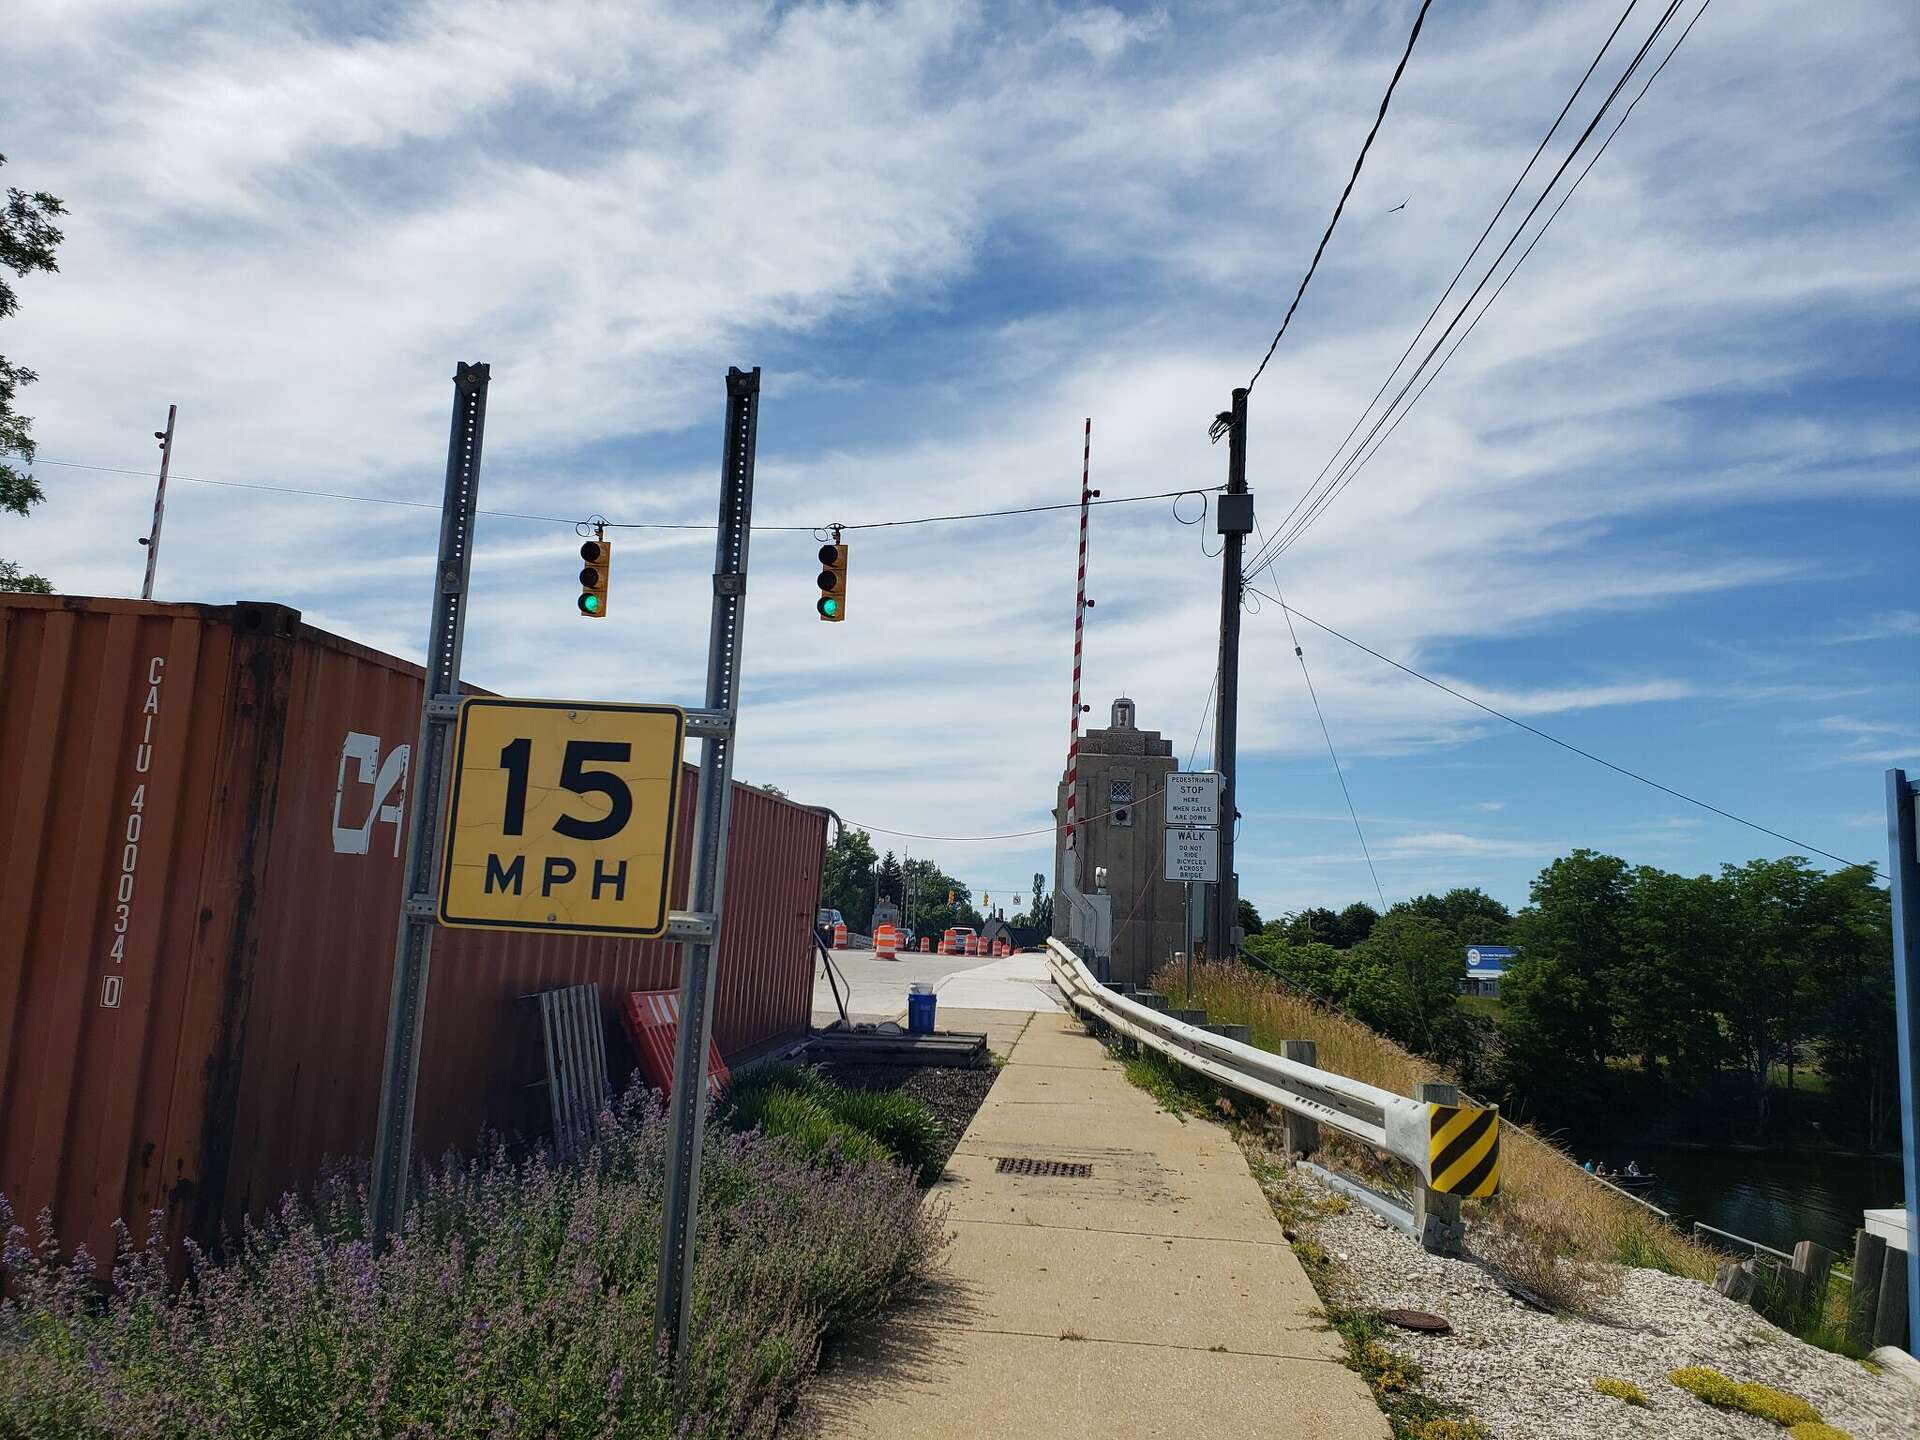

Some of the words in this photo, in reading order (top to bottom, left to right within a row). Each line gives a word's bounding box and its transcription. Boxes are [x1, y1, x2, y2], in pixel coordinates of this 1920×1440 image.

[135, 656, 165, 774] CAIU
[500, 738, 633, 841] 15
[1171, 776, 1214, 784] PEDESTRIANS
[1180, 786, 1204, 794] STOP
[1177, 832, 1205, 841] WALK
[110, 784, 145, 964] 400034
[484, 854, 628, 901] MPH
[102, 977, 122, 1008] 0
